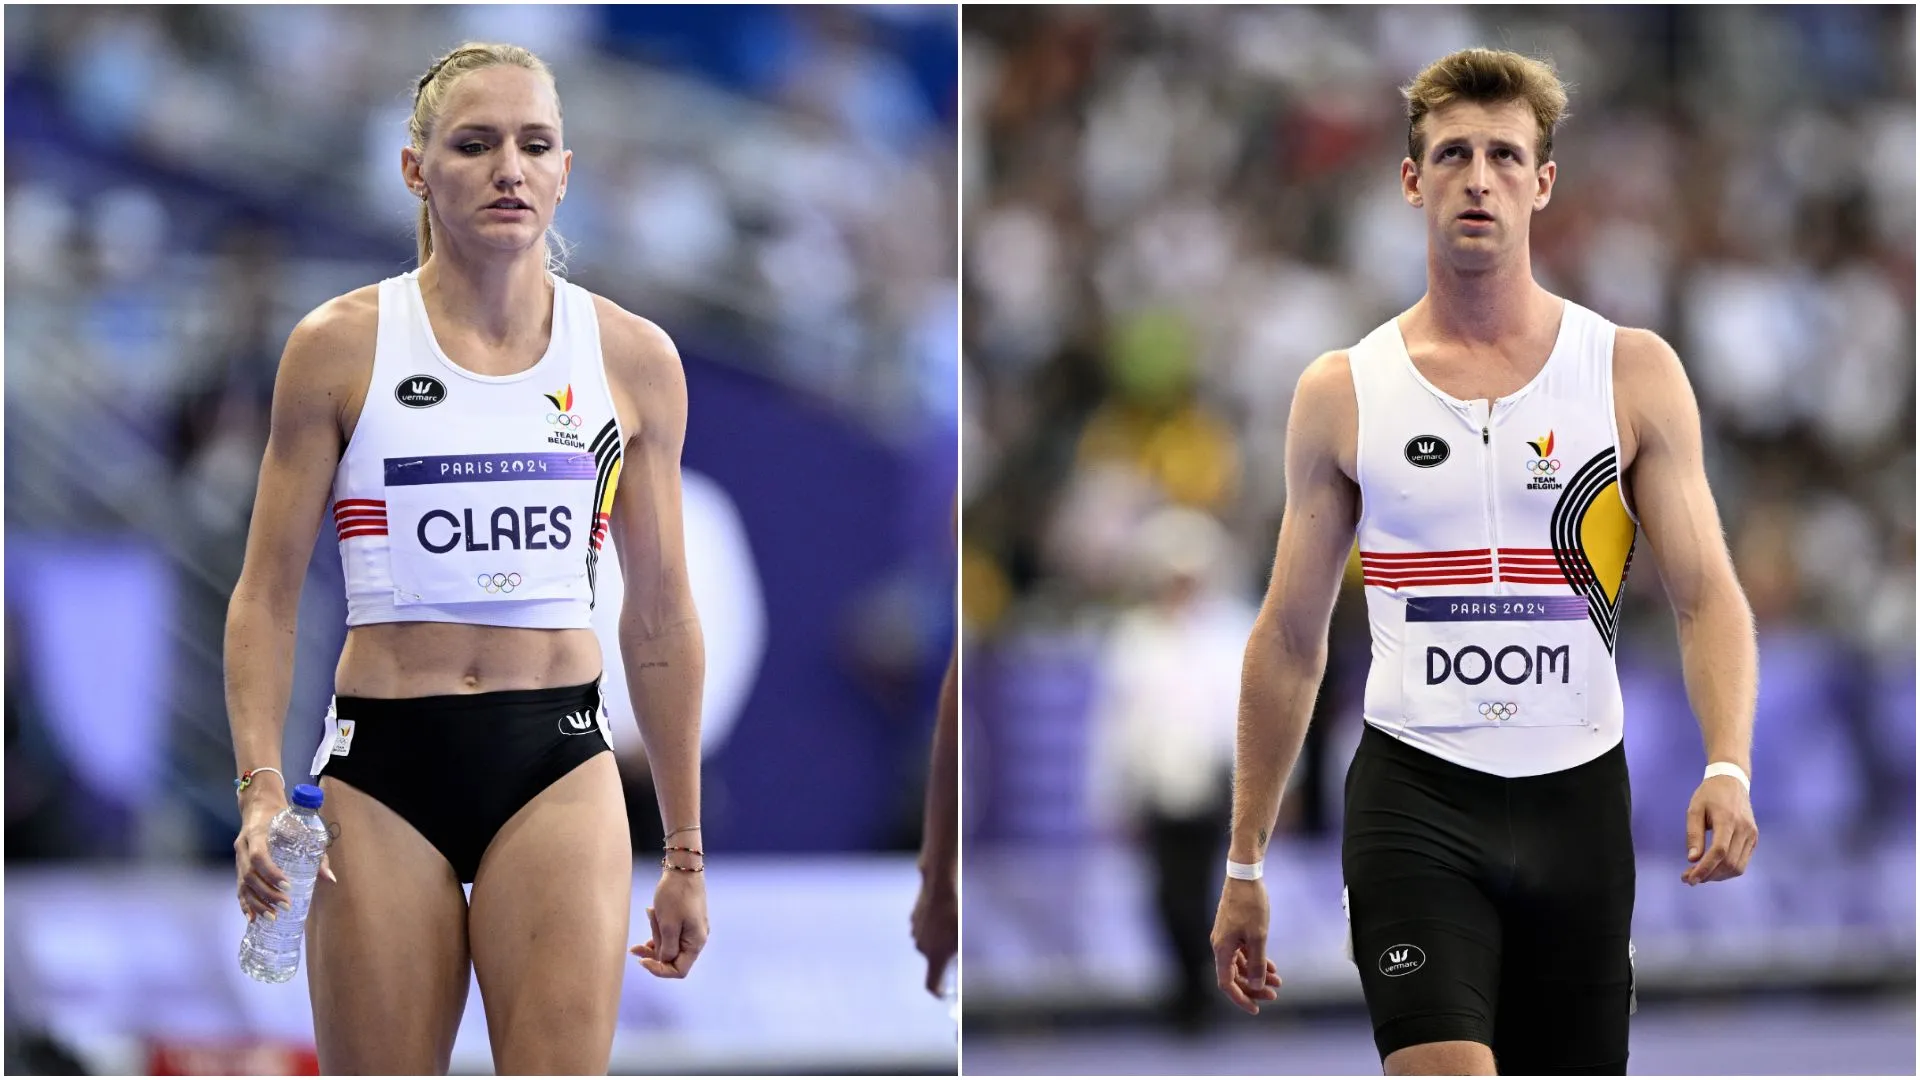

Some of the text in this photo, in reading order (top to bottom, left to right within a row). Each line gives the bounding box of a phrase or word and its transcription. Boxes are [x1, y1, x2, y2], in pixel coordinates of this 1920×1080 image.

[402, 394, 438, 402] vermarc
[554, 431, 578, 440] TEAM
[547, 437, 585, 449] BELGIUM
[440, 460, 547, 475] PARIS 2024
[417, 506, 572, 554] CLAES
[1450, 603, 1545, 614] PARIS 2024
[1426, 645, 1570, 686] DOOM
[1385, 961, 1418, 973] vermarc
